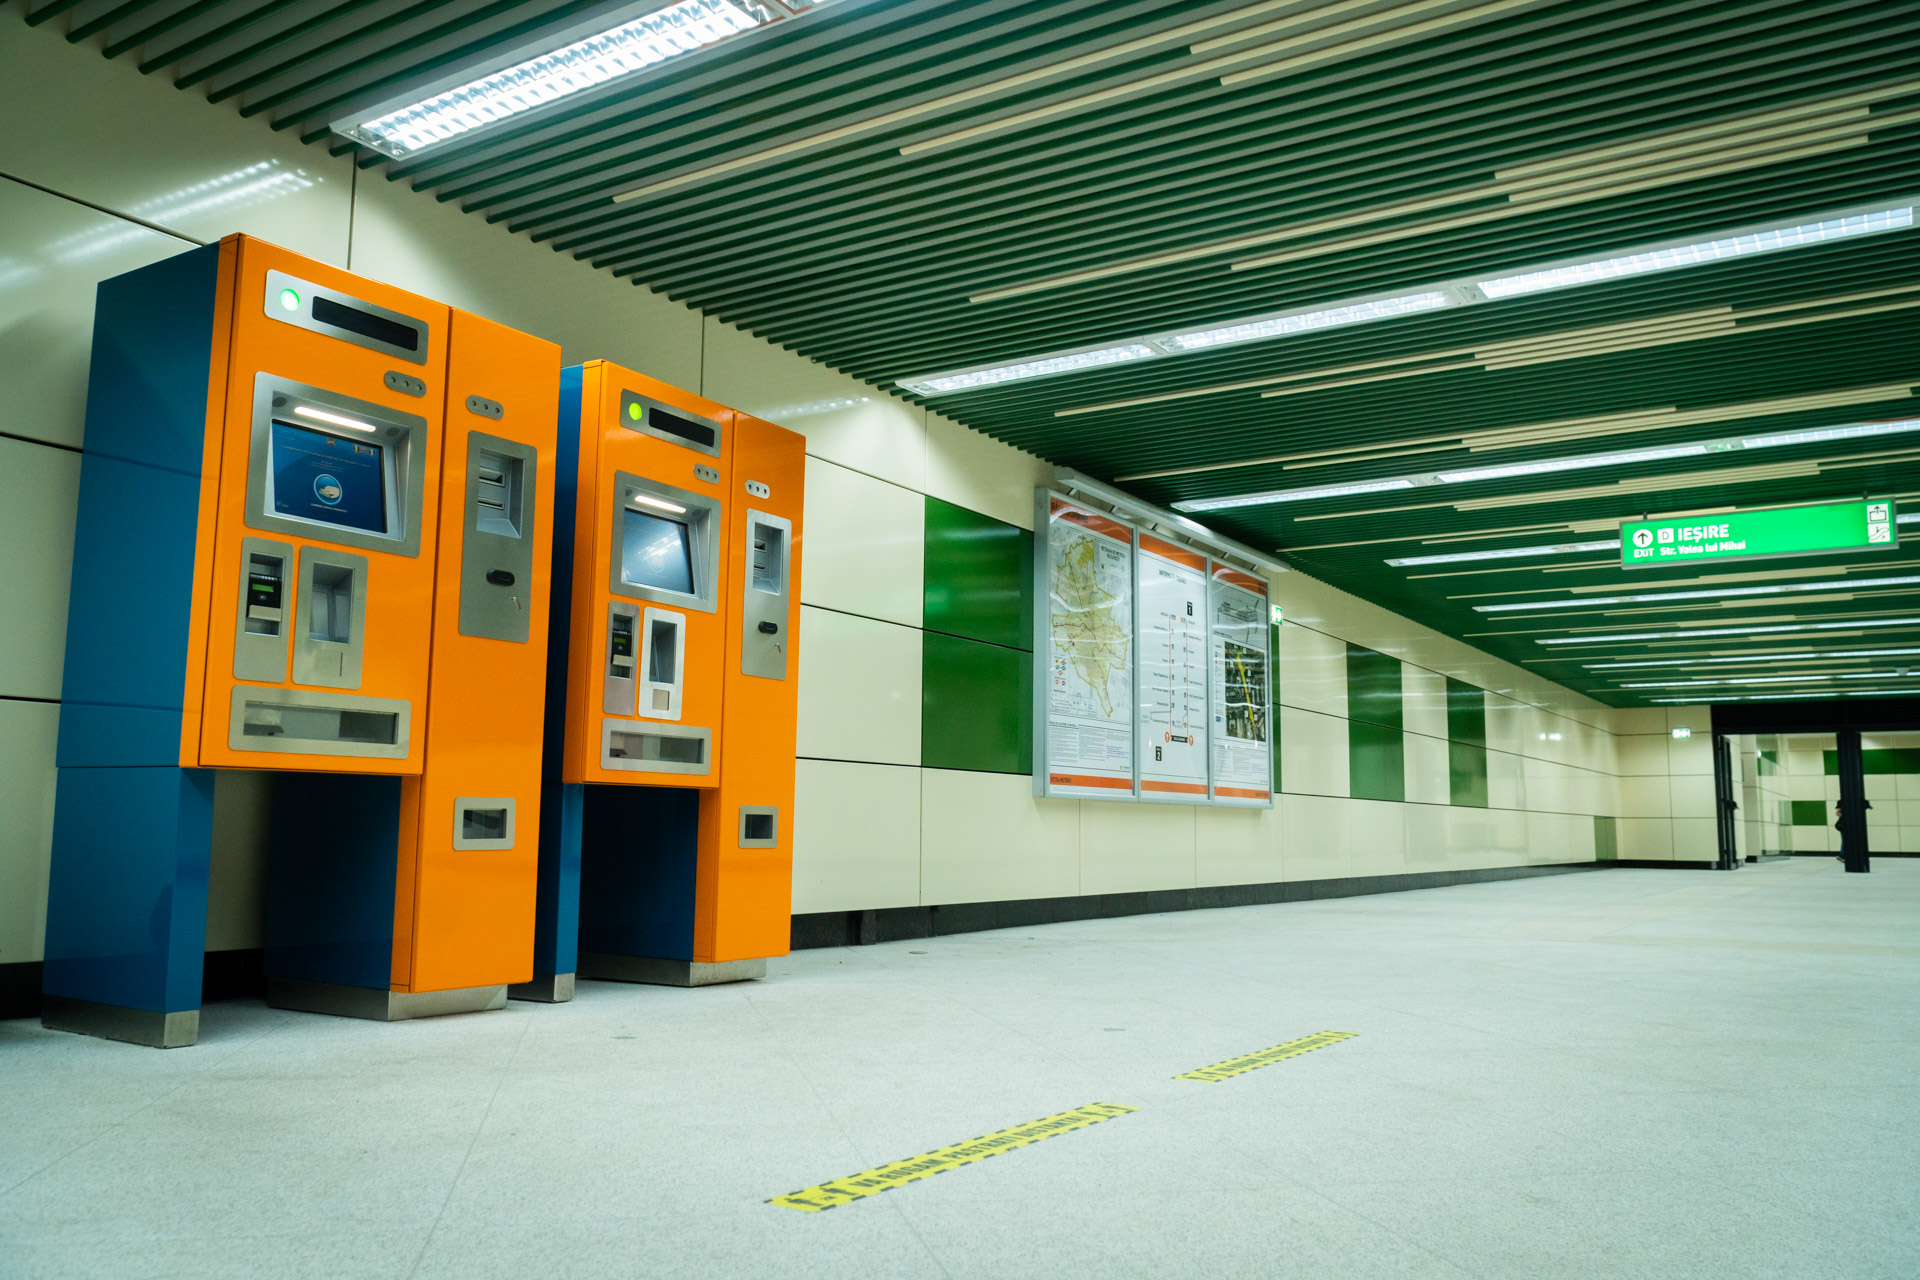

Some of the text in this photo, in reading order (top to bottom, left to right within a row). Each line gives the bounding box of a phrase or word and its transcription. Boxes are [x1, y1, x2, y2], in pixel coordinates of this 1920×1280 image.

[1633, 547, 1655, 558] EXIT
[1660, 540, 1747, 556] Str. Valea lui Mihai
